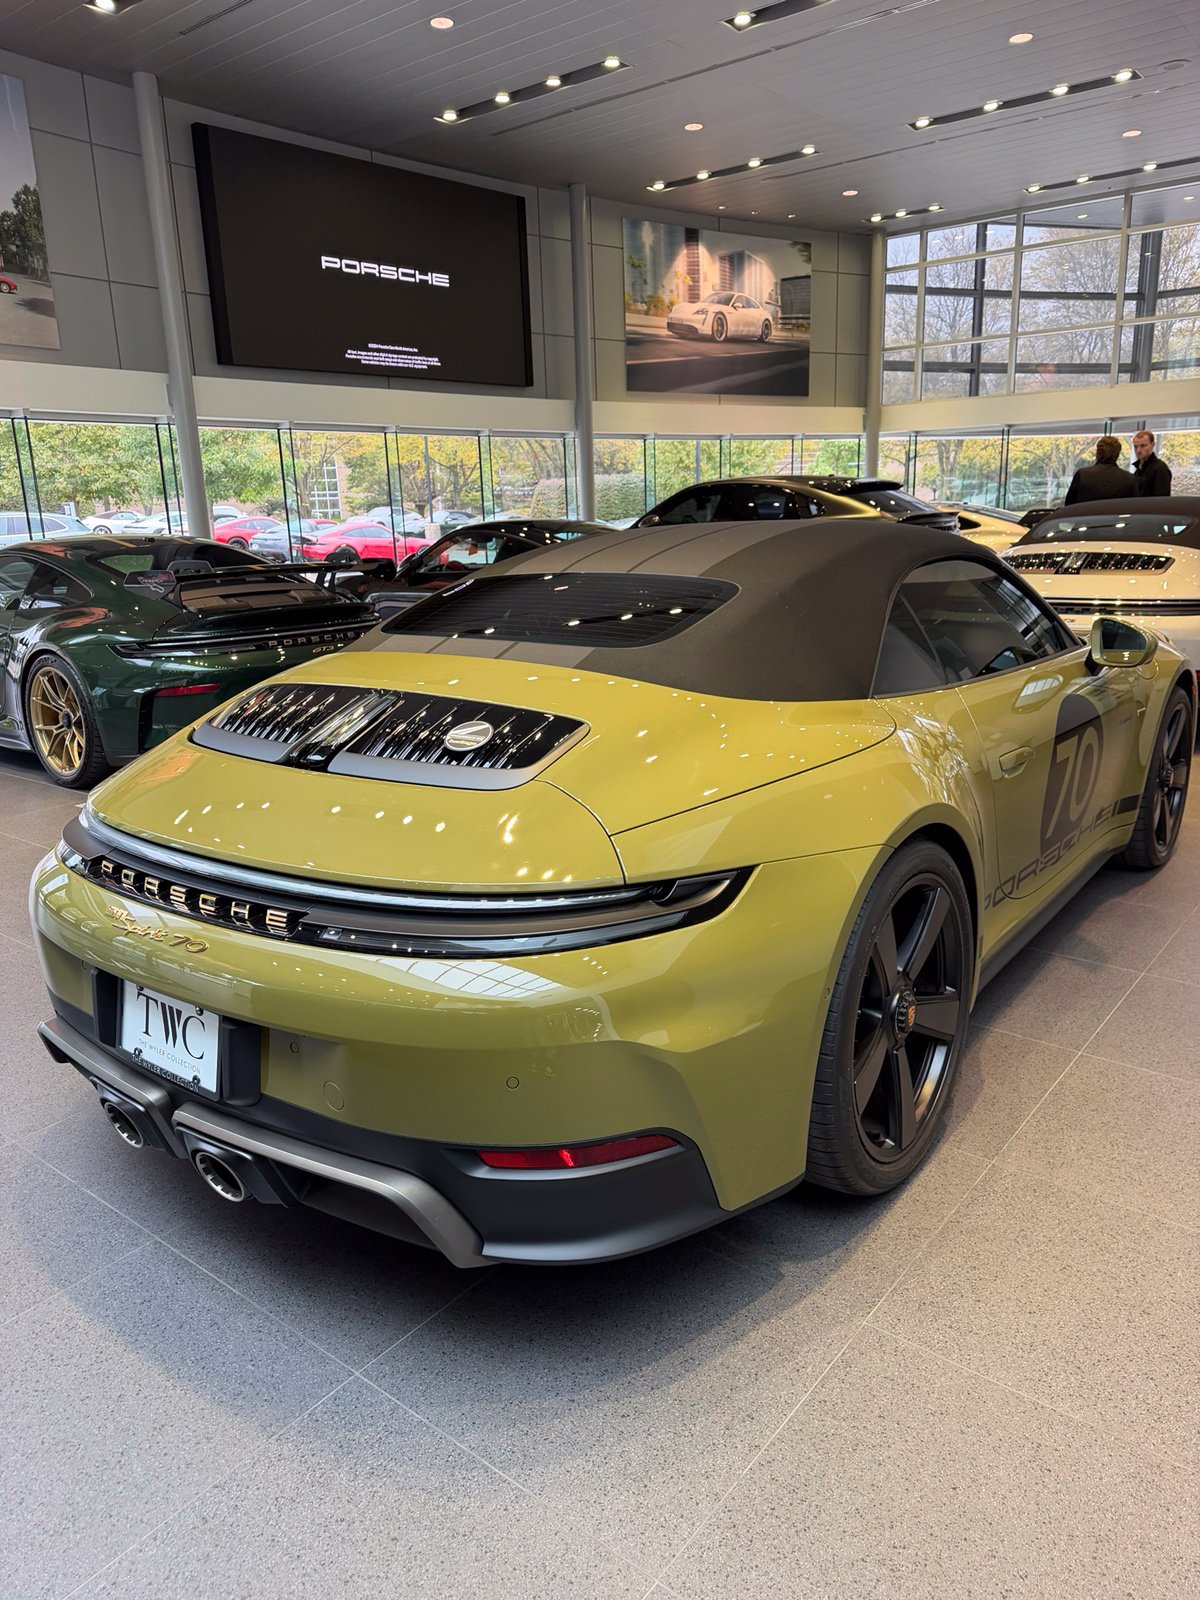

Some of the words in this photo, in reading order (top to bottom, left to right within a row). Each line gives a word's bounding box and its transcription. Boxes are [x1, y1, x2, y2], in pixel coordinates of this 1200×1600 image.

[320, 255, 450, 288] PORSCHE
[1044, 726, 1100, 840] 70
[101, 859, 290, 930] PORSCHE
[168, 933, 209, 953] 70
[136, 990, 206, 1060] TWC
[142, 1060, 161, 1075] WYLER
[161, 1069, 199, 1092] COLLECTION
[149, 1044, 165, 1056] WYLER
[166, 1052, 201, 1075] COLLECTION
